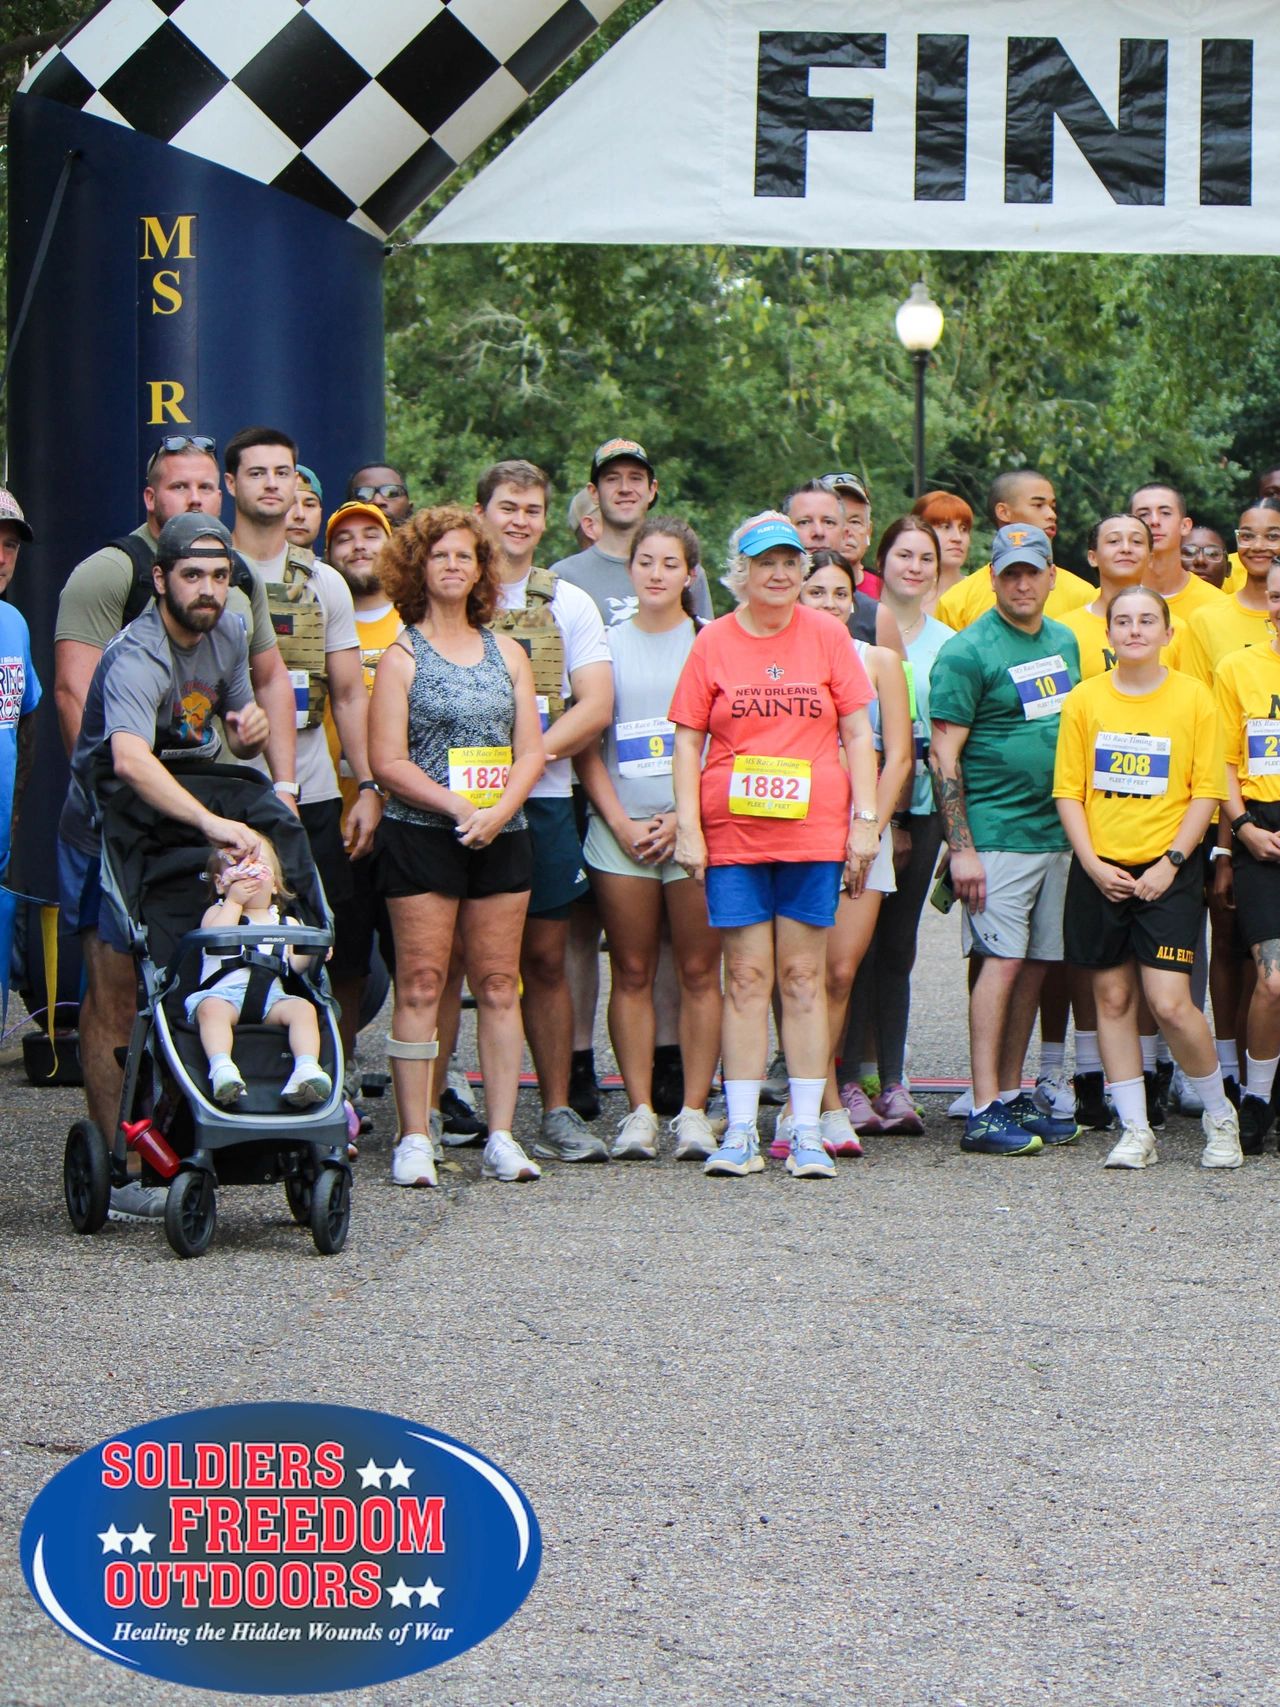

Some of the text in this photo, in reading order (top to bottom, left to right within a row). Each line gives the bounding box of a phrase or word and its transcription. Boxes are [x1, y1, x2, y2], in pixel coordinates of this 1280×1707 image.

[1007, 531, 1028, 548] T
[736, 687, 818, 697] NEW ORLEANS
[1035, 675, 1057, 698] 10
[731, 697, 823, 719] SAINTS
[648, 735, 665, 758] 9
[1109, 751, 1151, 776] 208
[462, 767, 509, 788] 1826
[741, 774, 800, 800] 1882
[1156, 945, 1175, 960] ALL
